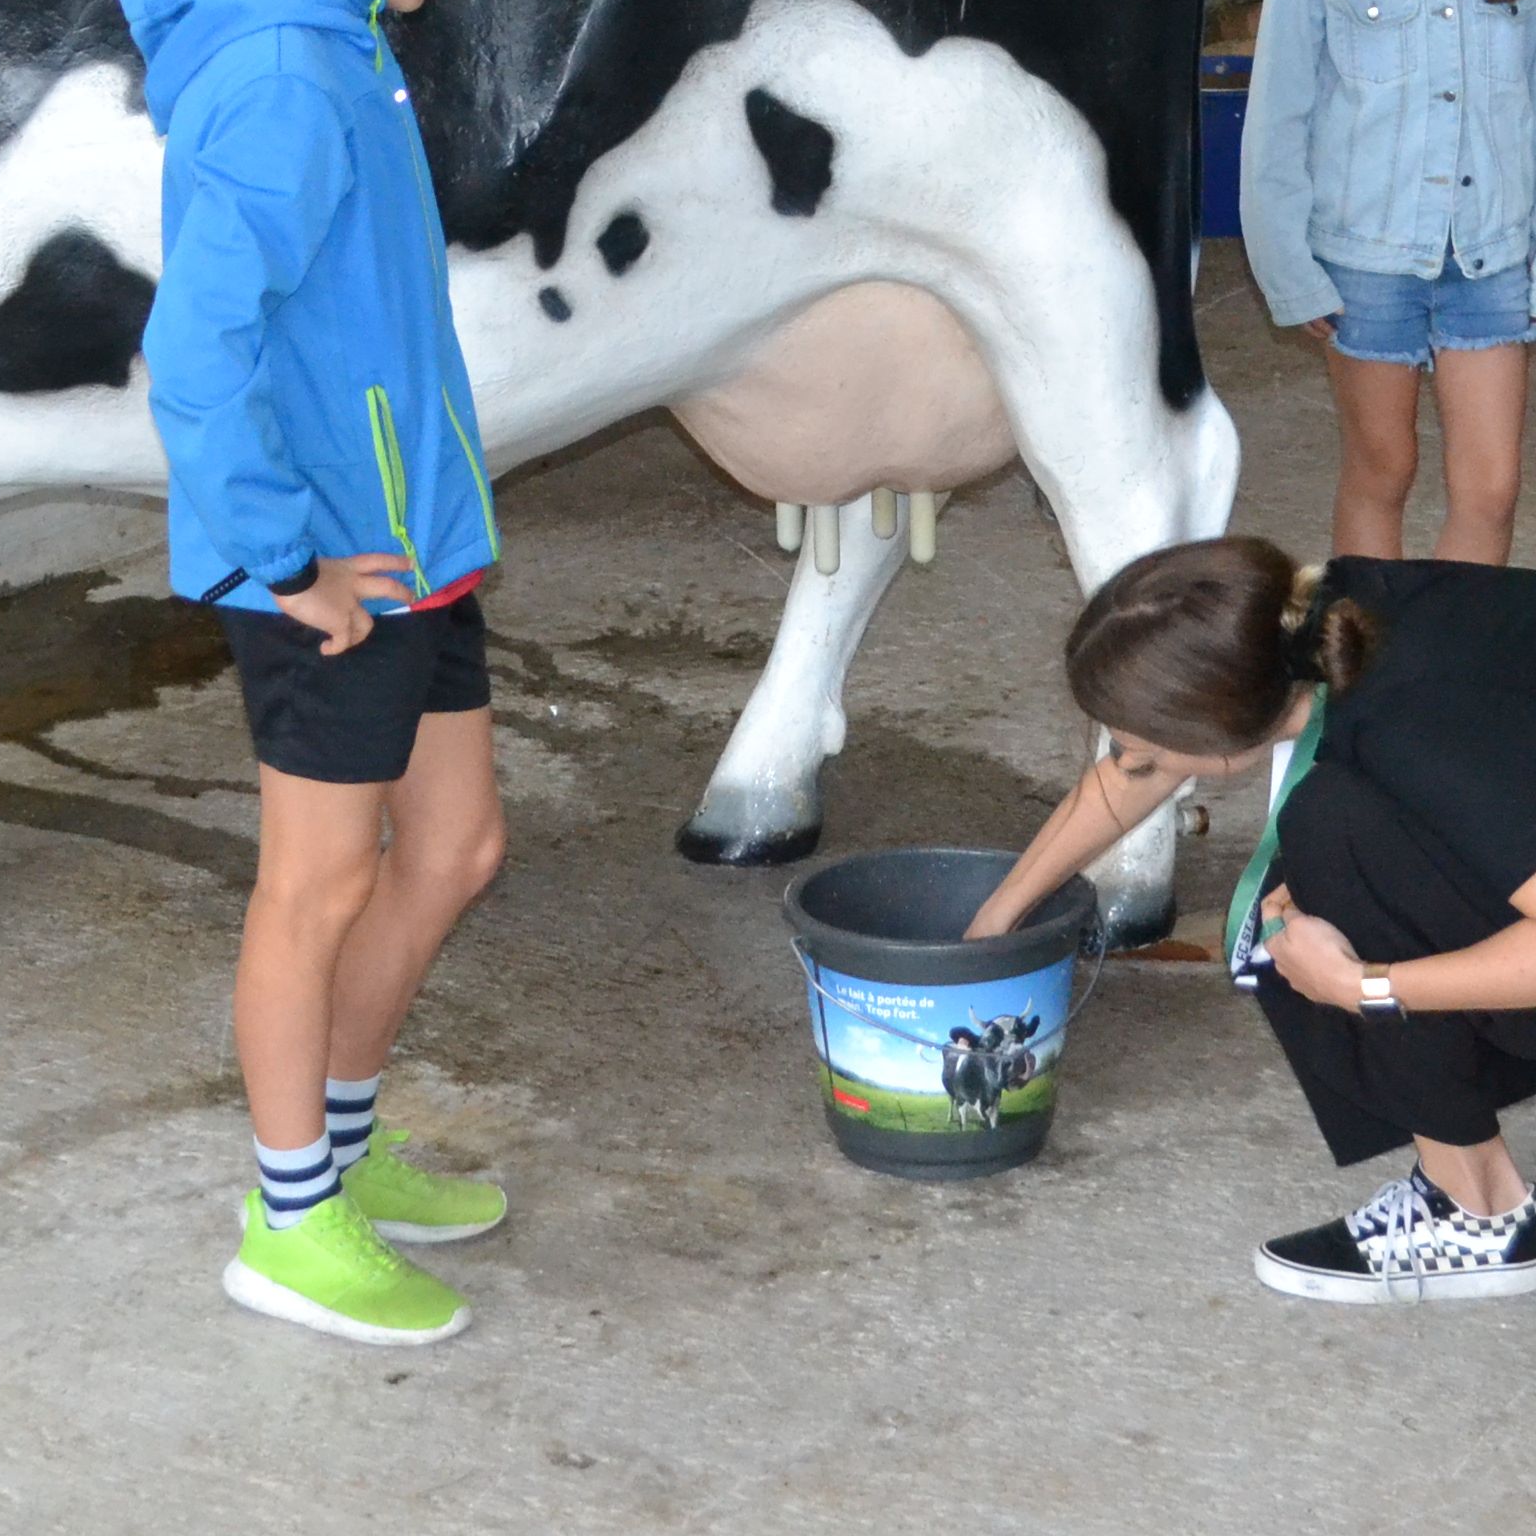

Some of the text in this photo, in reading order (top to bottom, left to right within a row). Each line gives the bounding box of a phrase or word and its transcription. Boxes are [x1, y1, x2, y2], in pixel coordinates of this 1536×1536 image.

[1236, 943, 1249, 961] FC
[848, 987, 865, 1001] lait
[877, 995, 916, 1007] portée
[919, 996, 935, 1008] de
[865, 1004, 891, 1019] Trop
[893, 1007, 920, 1019] fort.
